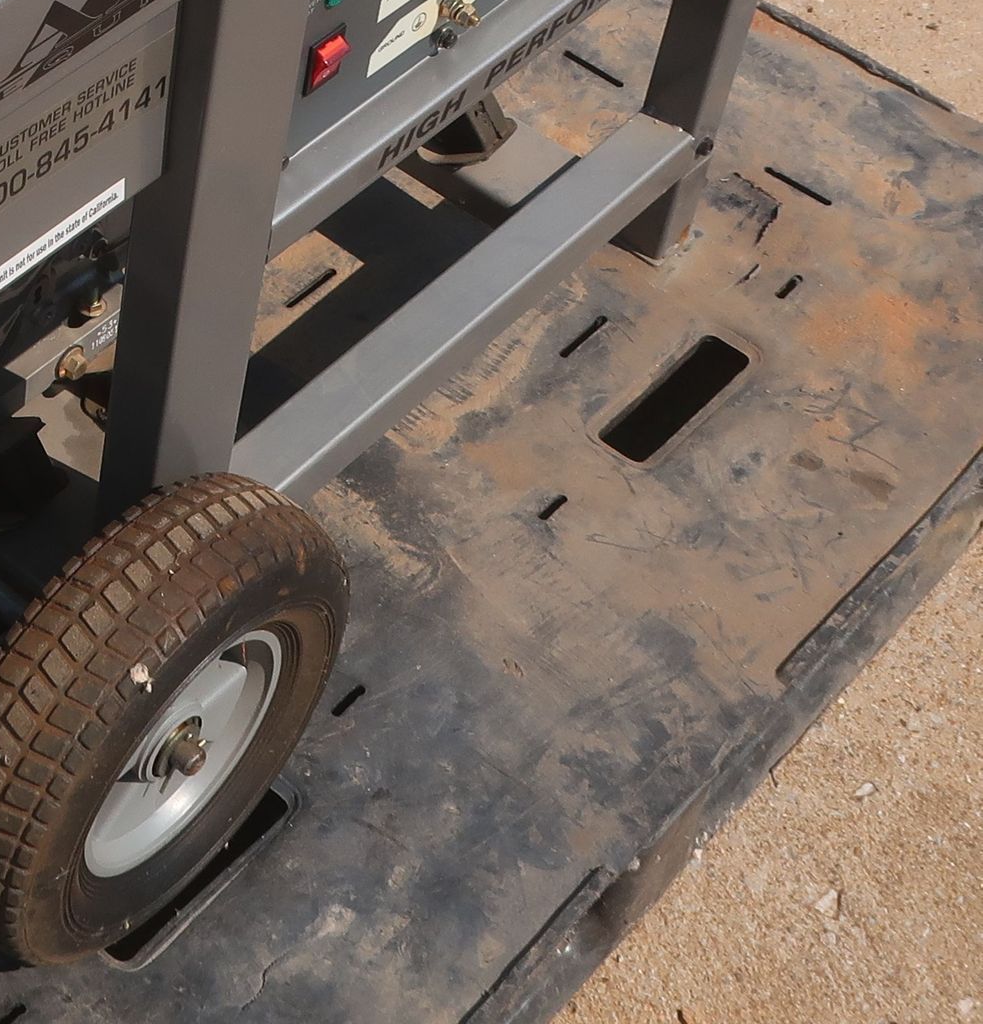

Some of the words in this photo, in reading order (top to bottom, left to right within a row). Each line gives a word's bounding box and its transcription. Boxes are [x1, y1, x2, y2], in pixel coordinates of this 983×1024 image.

[377, 30, 405, 53] GROUND
[29, 118, 67, 152] FREE
[73, 74, 135, 123] HOTLINE
[76, 57, 137, 106] SERVICE
[377, 88, 469, 170] HIGH
[9, 266, 15, 276] is
[15, 257, 26, 271] not
[26, 250, 36, 263] for
[36, 243, 47, 255] use
[47, 238, 54, 249] in
[54, 231, 65, 244] the
[65, 218, 81, 235] state
[81, 211, 89, 223] of
[89, 192, 119, 218] California.
